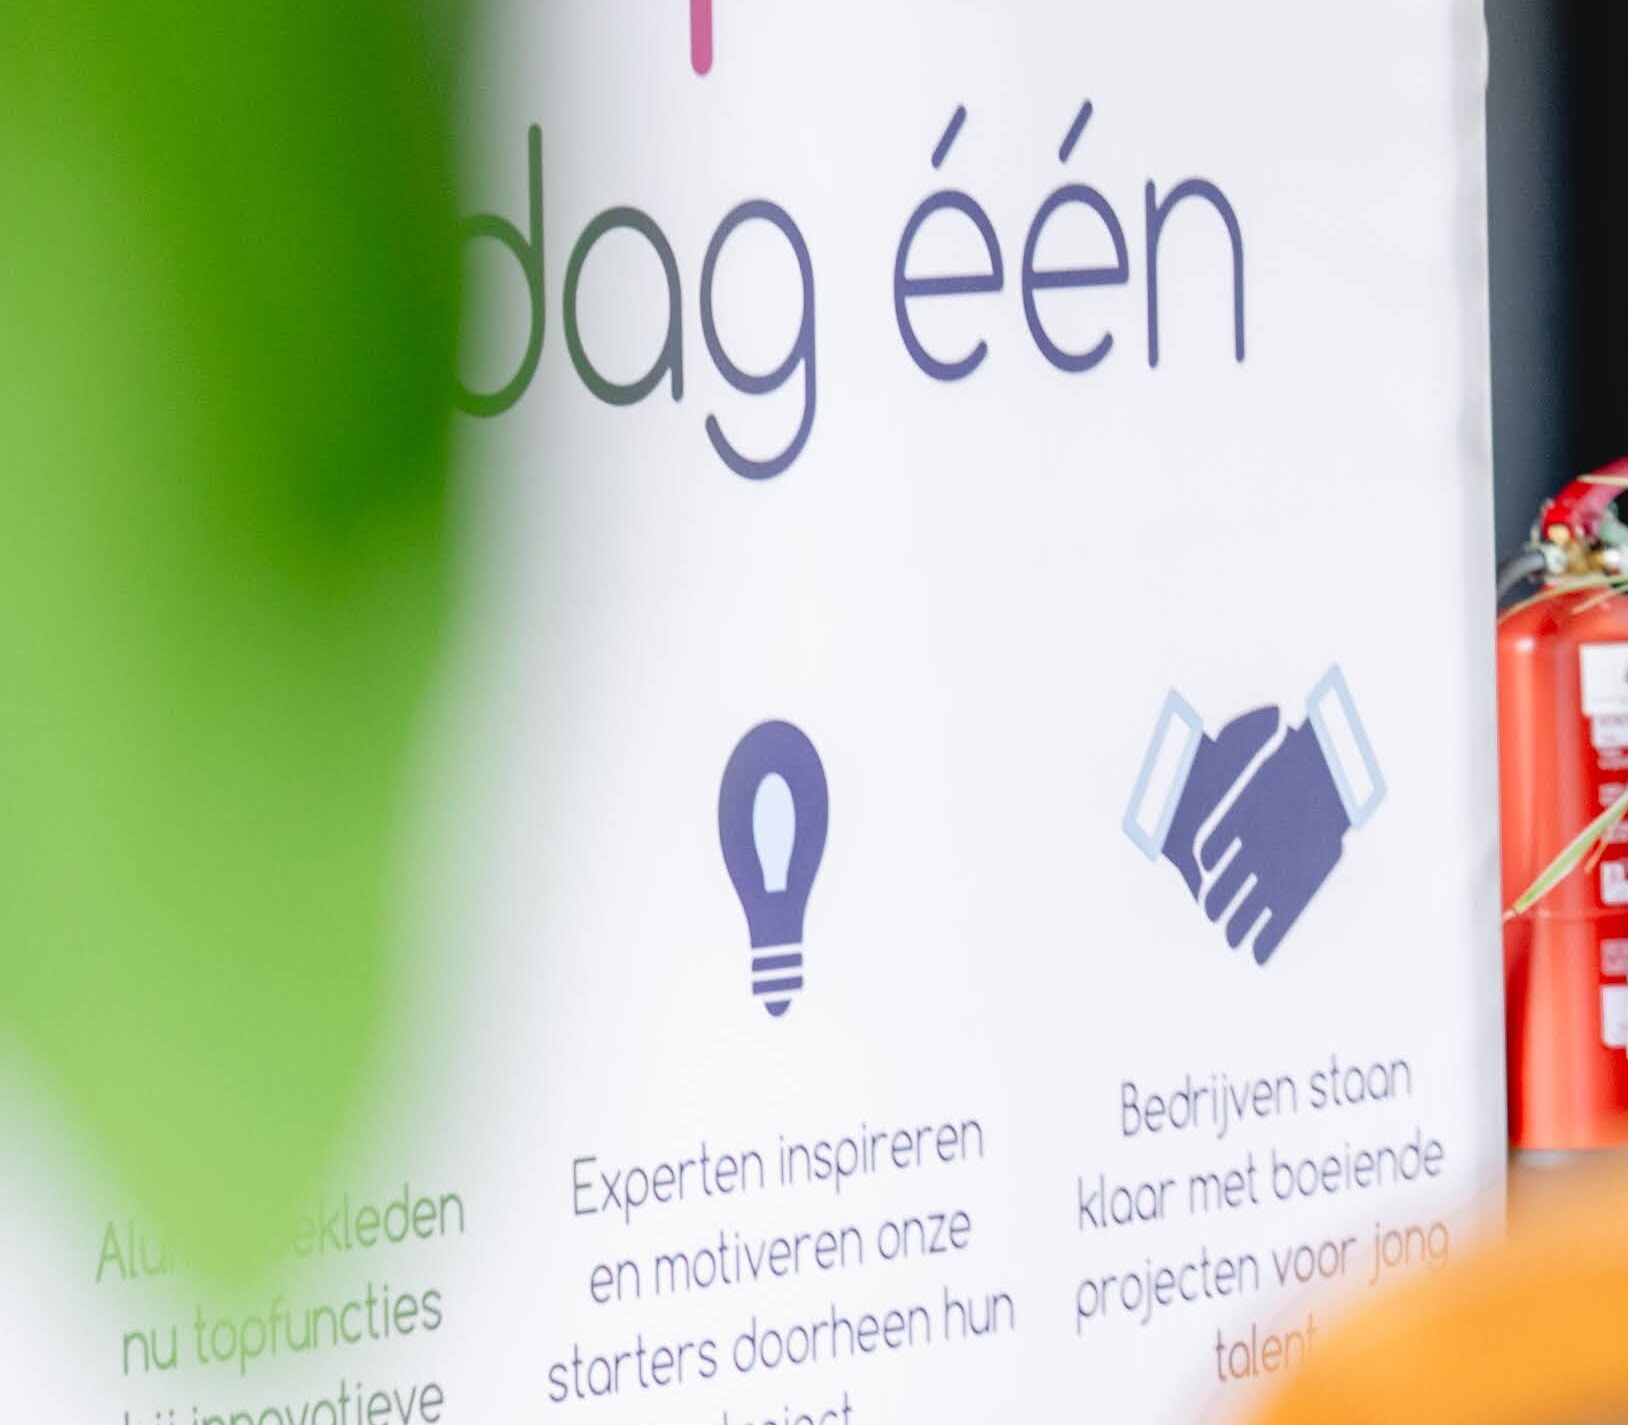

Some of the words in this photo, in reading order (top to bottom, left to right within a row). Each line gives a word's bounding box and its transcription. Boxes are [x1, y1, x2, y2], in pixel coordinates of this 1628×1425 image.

[450, 122, 817, 481] dag
[893, 99, 1246, 382] één
[1120, 1072, 1298, 1141] Bedrijven
[1308, 1053, 1412, 1110] staan
[288, 1180, 467, 1260] ekleden
[571, 1140, 765, 1227] Experten
[779, 1118, 984, 1195] inspireren
[1077, 1173, 1177, 1232] klaar
[1188, 1151, 1260, 1214] met
[1271, 1126, 1446, 1202] boeiende
[589, 1258, 641, 1306] en
[653, 1224, 864, 1296] motiveren
[876, 1209, 973, 1262] onze
[1074, 1245, 1261, 1337] projecten
[1271, 1236, 1358, 1288] voor
[1370, 1220, 1450, 1287] jong
[121, 1324, 179, 1376] nu
[193, 1280, 445, 1378] topfuncties
[547, 1332, 719, 1405] starters
[732, 1301, 932, 1374] doorheen
[943, 1284, 1015, 1341] hun
